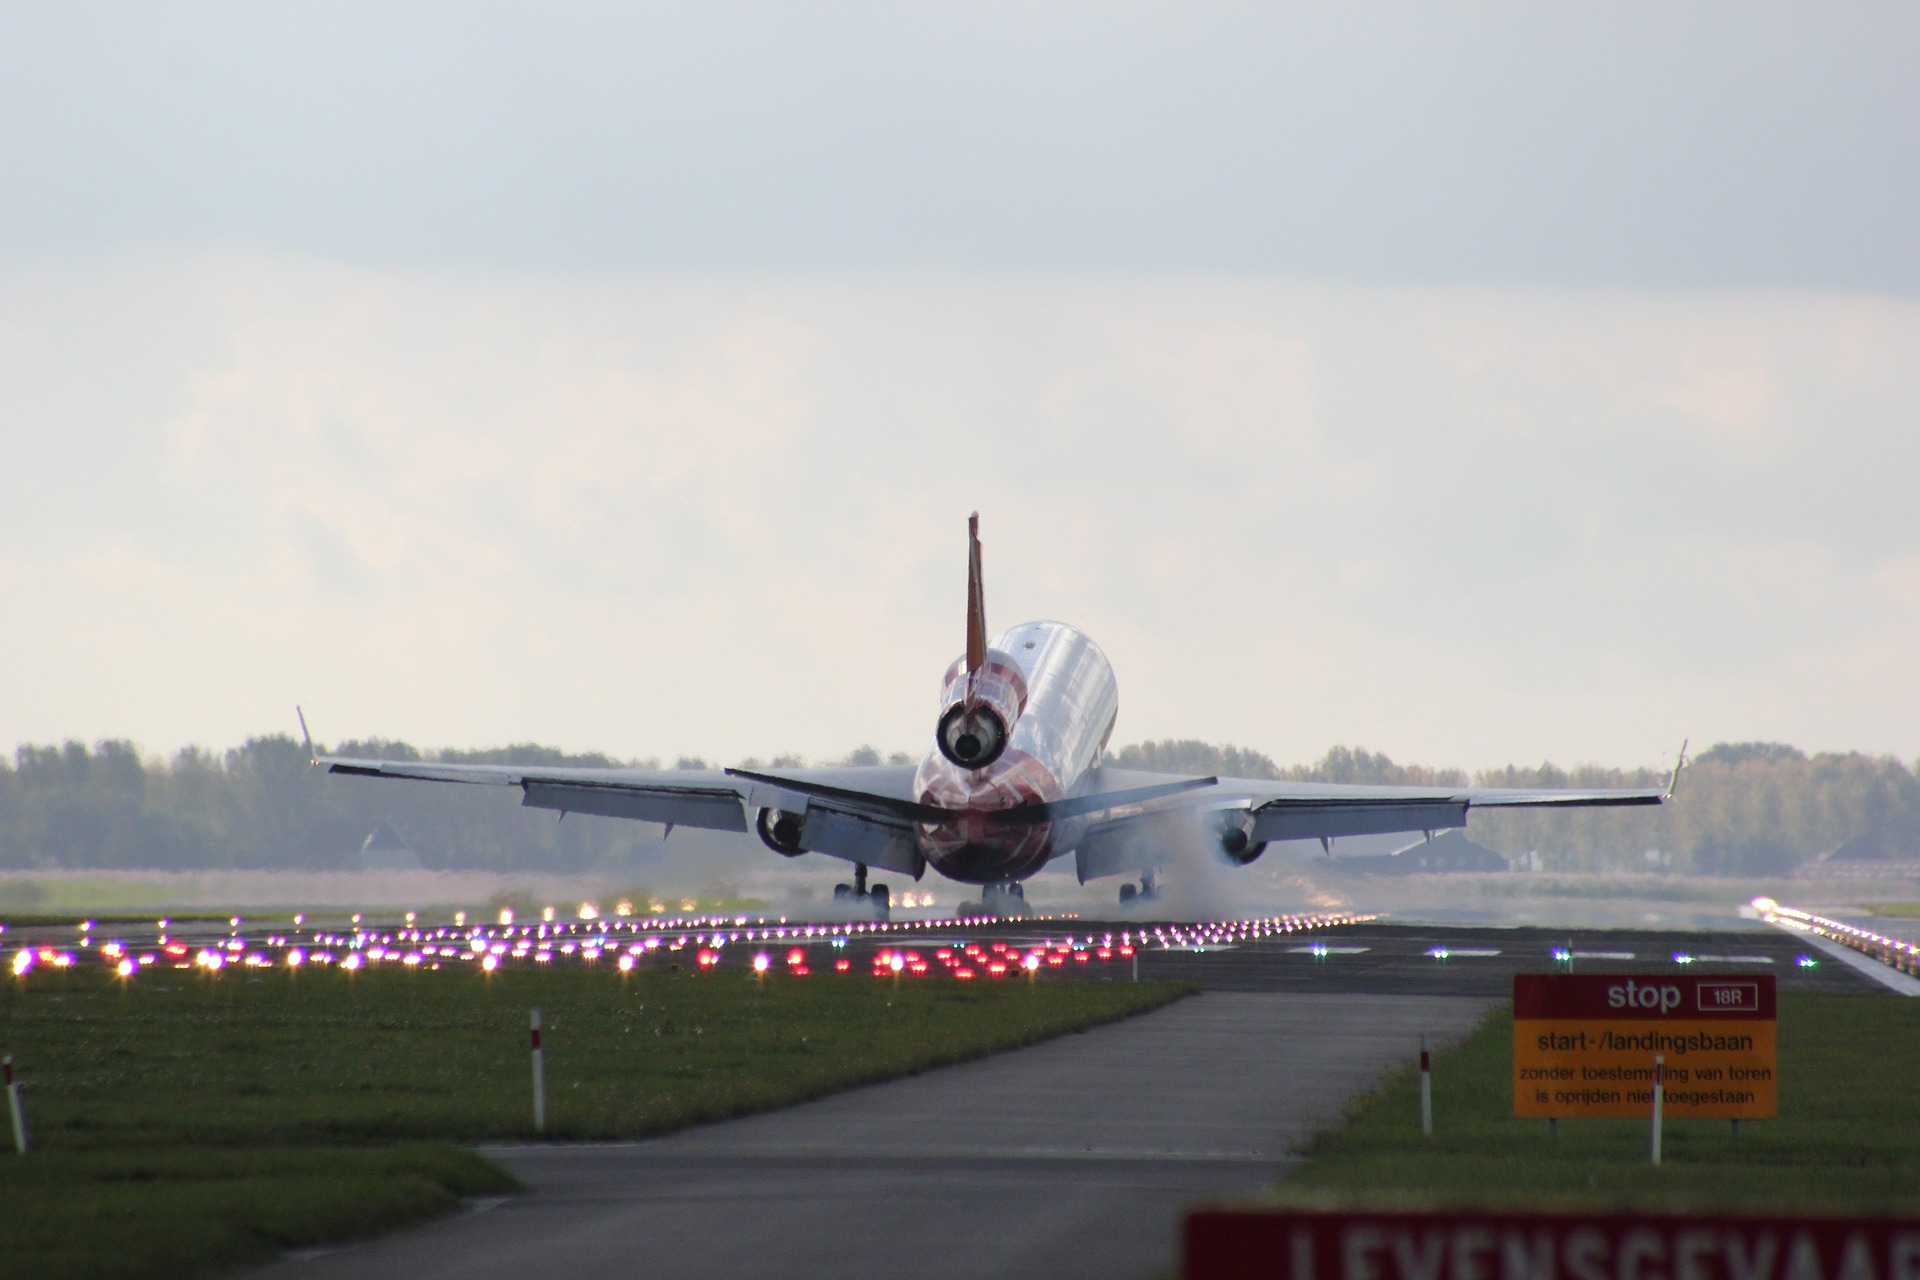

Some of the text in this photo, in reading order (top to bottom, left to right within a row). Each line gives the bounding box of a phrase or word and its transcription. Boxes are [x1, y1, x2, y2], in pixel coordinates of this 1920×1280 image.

[1607, 980, 1682, 1014] stop
[1713, 989, 1743, 1005] 18R
[1520, 1066, 1576, 1081] zonder
[1695, 1068, 1724, 1081] van
[1728, 1066, 1772, 1081] toren
[1536, 1088, 1755, 1106] is oprijden niet toegestaan
